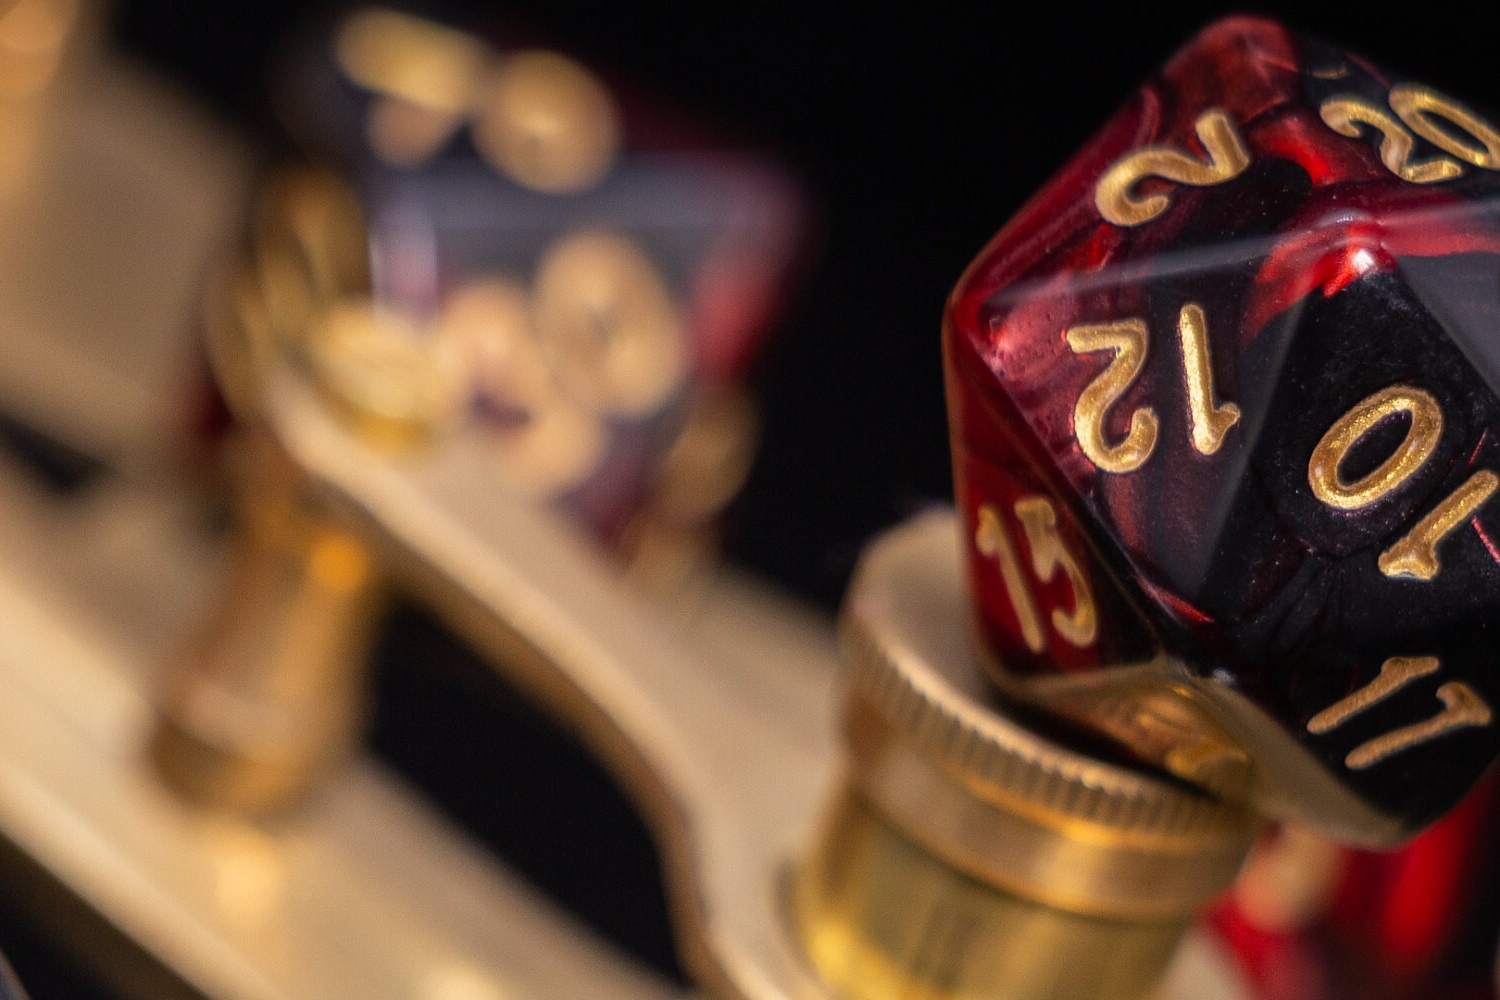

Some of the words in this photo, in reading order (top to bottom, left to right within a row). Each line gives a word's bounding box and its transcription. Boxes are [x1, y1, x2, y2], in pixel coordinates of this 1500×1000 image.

[1094, 107, 1250, 227] 2
[1319, 83, 1500, 184] 20
[1066, 303, 1240, 473] 12
